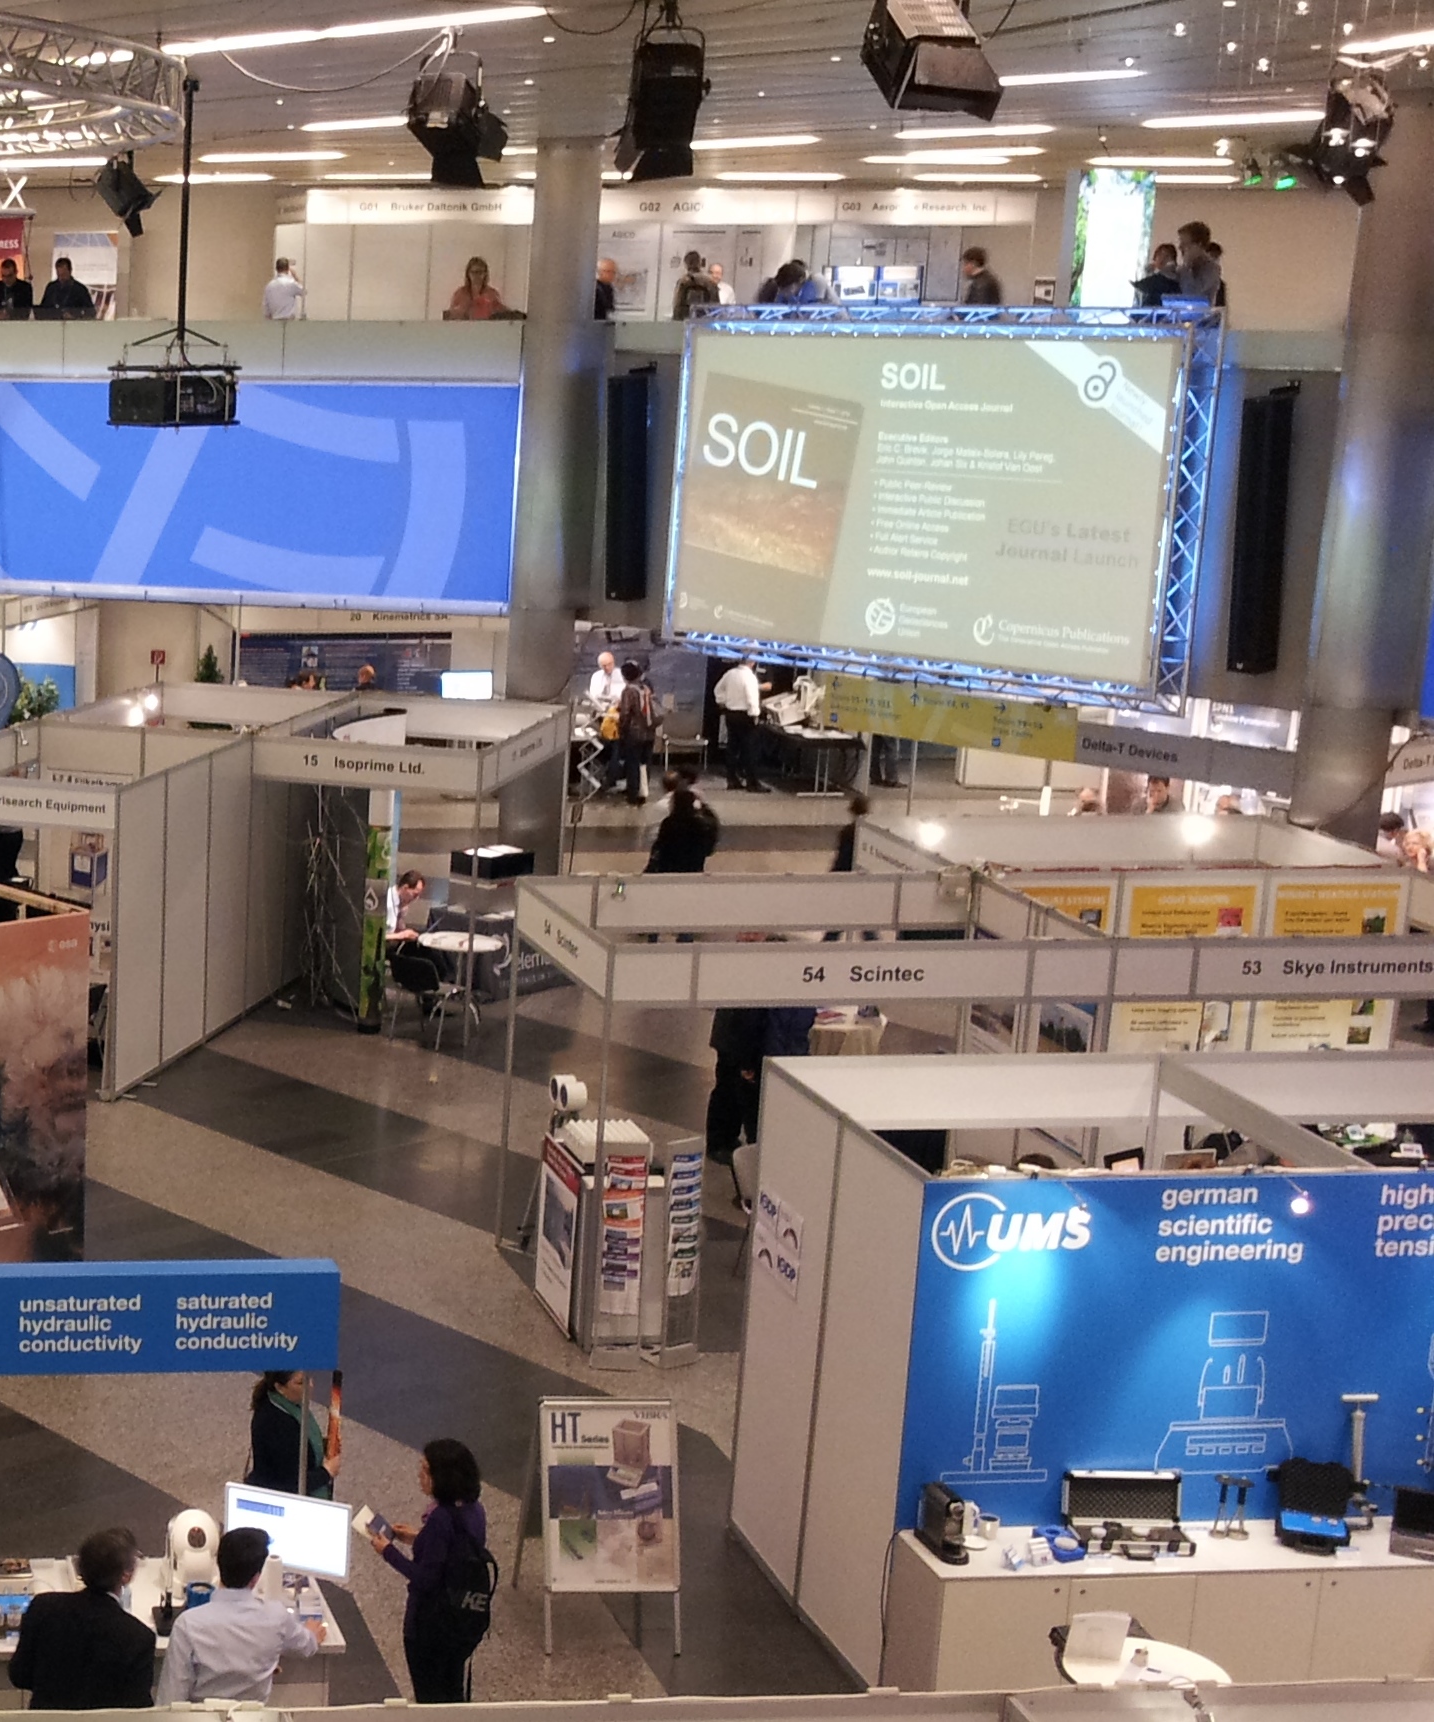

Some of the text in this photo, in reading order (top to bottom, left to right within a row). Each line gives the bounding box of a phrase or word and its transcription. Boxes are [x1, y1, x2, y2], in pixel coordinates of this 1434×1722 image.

[359, 202, 502, 212] G01 Bruker Daltonik GmbH
[639, 202, 661, 213] G02
[842, 201, 861, 211] G03
[881, 362, 946, 391] SOIL
[880, 399, 1014, 413] Interactive Open Access Journal
[878, 431, 949, 444] Executive Editors
[702, 413, 817, 489] SOIL
[1007, 517, 1131, 543] EGU's Latest
[995, 542, 1139, 570] Journal Launch
[867, 567, 969, 586] www.soil-journal.net
[998, 619, 1130, 647] Copernicus Publications
[1082, 737, 1179, 763] Delta-T Devices
[303, 754, 426, 774] 15 Isoprime Ltd.
[45, 799, 107, 815] Equipment
[556, 929, 579, 959] Scintec
[802, 965, 926, 983] 54 Scintec
[1241, 959, 1434, 978] 53 Skye Instruments
[986, 1183, 1434, 1252] UMS german high
[1158, 1213, 1273, 1238] scientific
[1155, 1238, 1305, 1267] engineering
[19, 1294, 142, 1313] unsaturated
[176, 1292, 273, 1311] saturated
[19, 1312, 268, 1335] hydraulic hydraulic
[19, 1332, 299, 1355] conductivity conductivity
[551, 1412, 581, 1444] HT
[581, 1434, 610, 1444] Series
